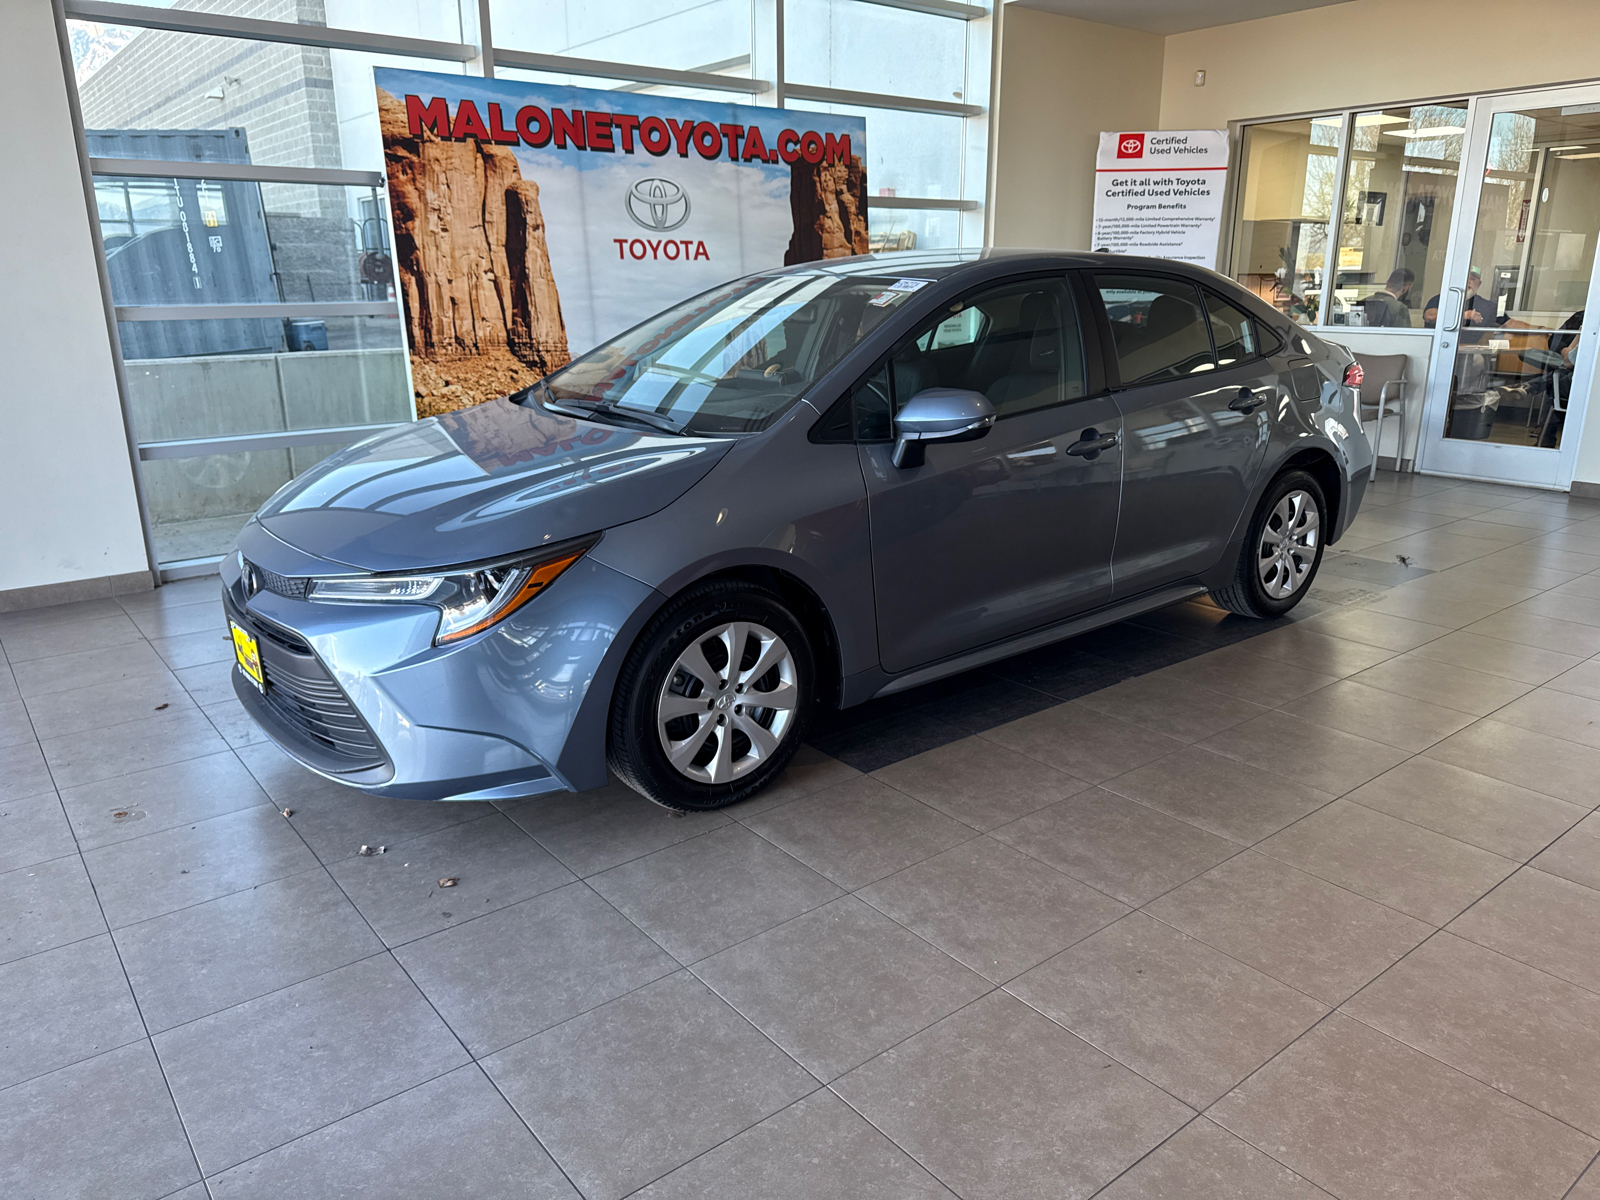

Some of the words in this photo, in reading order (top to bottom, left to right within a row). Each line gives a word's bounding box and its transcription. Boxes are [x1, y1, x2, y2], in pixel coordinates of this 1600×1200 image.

[405, 94, 852, 166] MALONETOYOTA.COM
[1150, 136, 1188, 145] Certified
[1149, 146, 1171, 154] Used
[1173, 146, 1208, 154] Vehicles
[1112, 178, 1128, 187] Get
[1130, 178, 1137, 186] it
[1139, 178, 1151, 186] all
[1153, 178, 1174, 186] with
[1175, 178, 1206, 187] Toyota
[1105, 189, 1146, 198] Certified
[1147, 188, 1171, 197] Used
[1173, 188, 1211, 196] Vehicles
[1127, 203, 1157, 211] Program
[613, 238, 711, 261] TOYOTA
